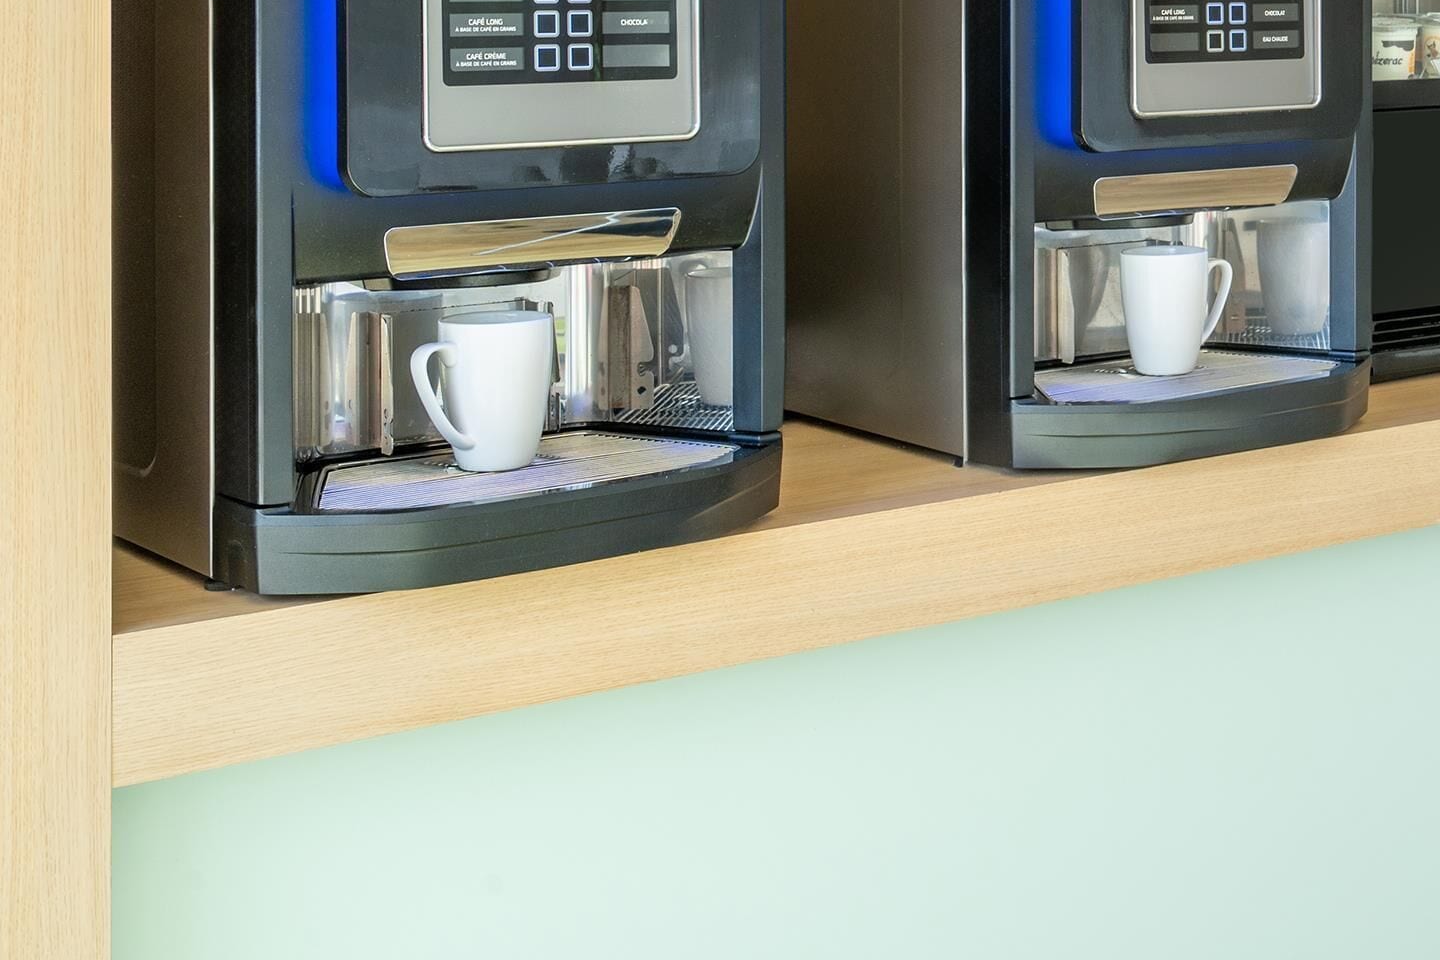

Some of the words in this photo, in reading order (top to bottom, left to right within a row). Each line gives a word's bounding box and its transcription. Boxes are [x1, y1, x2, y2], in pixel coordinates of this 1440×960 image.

[468, 17, 485, 26] CAFÉ
[486, 18, 503, 26] LONG
[466, 52, 482, 60] CAFÉ
